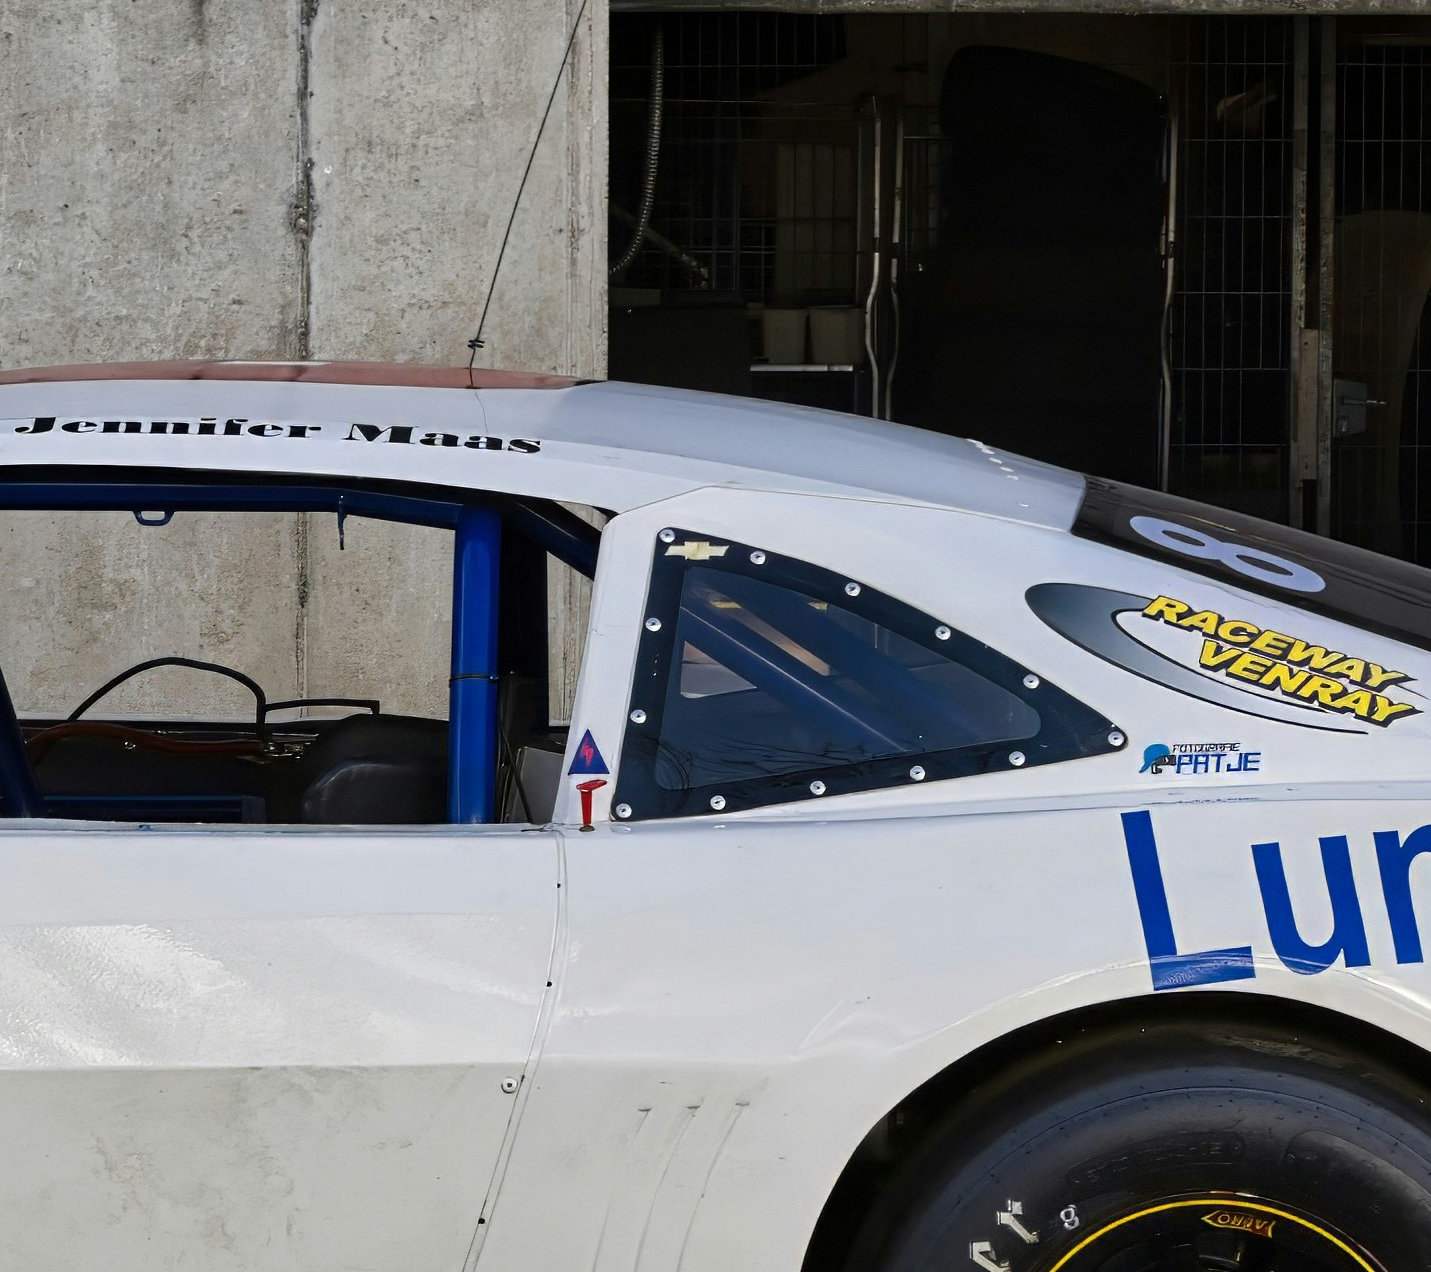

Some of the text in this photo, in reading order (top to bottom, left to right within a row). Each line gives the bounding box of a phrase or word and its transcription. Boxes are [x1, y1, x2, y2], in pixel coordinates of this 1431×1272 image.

[16, 415, 543, 455] Jennifer Maas
[1141, 594, 1419, 690] RACEWAY
[1198, 637, 1422, 727] VENRAY
[1176, 753, 1261, 774] PATJE
